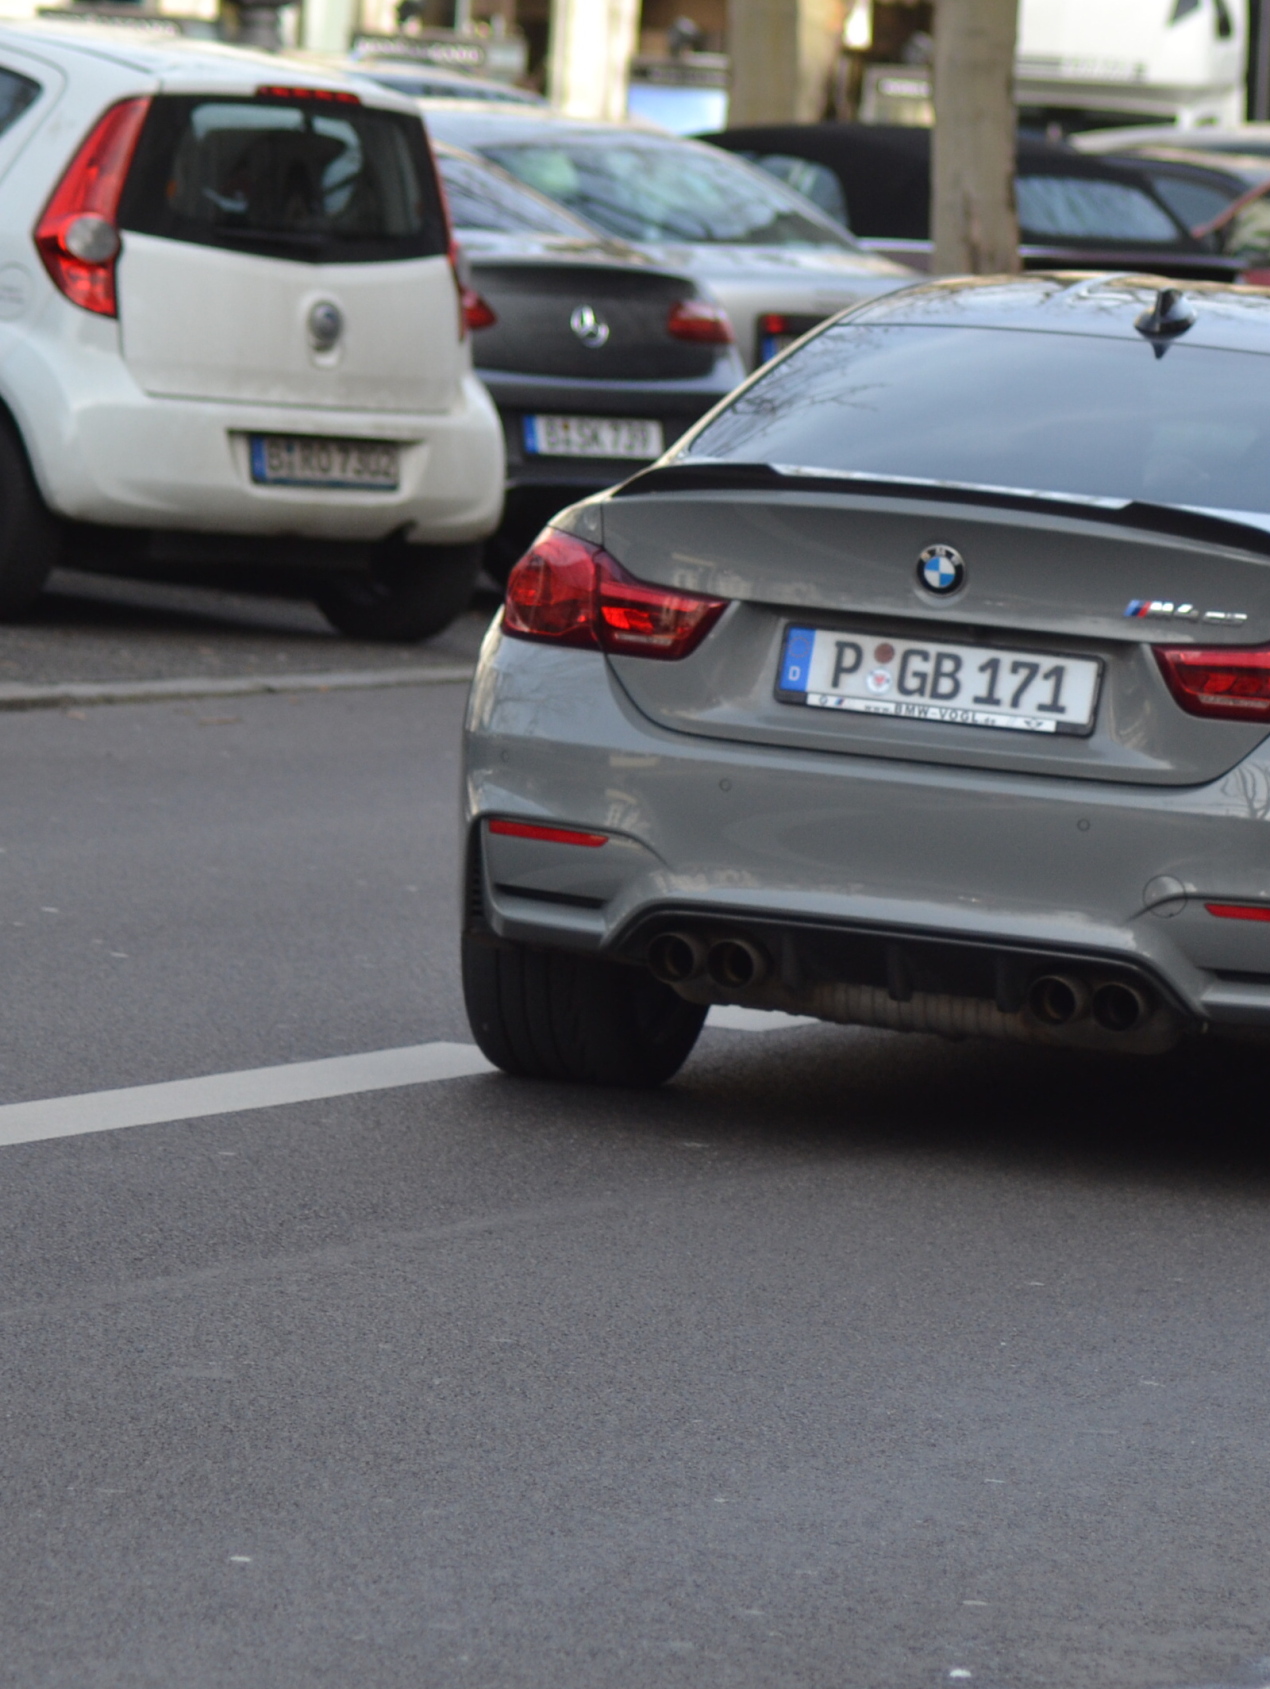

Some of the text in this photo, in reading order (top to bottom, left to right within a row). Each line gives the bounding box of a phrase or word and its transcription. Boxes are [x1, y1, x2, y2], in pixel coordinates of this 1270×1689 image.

[789, 665, 801, 681] D
[831, 640, 1066, 714] P GB 171
